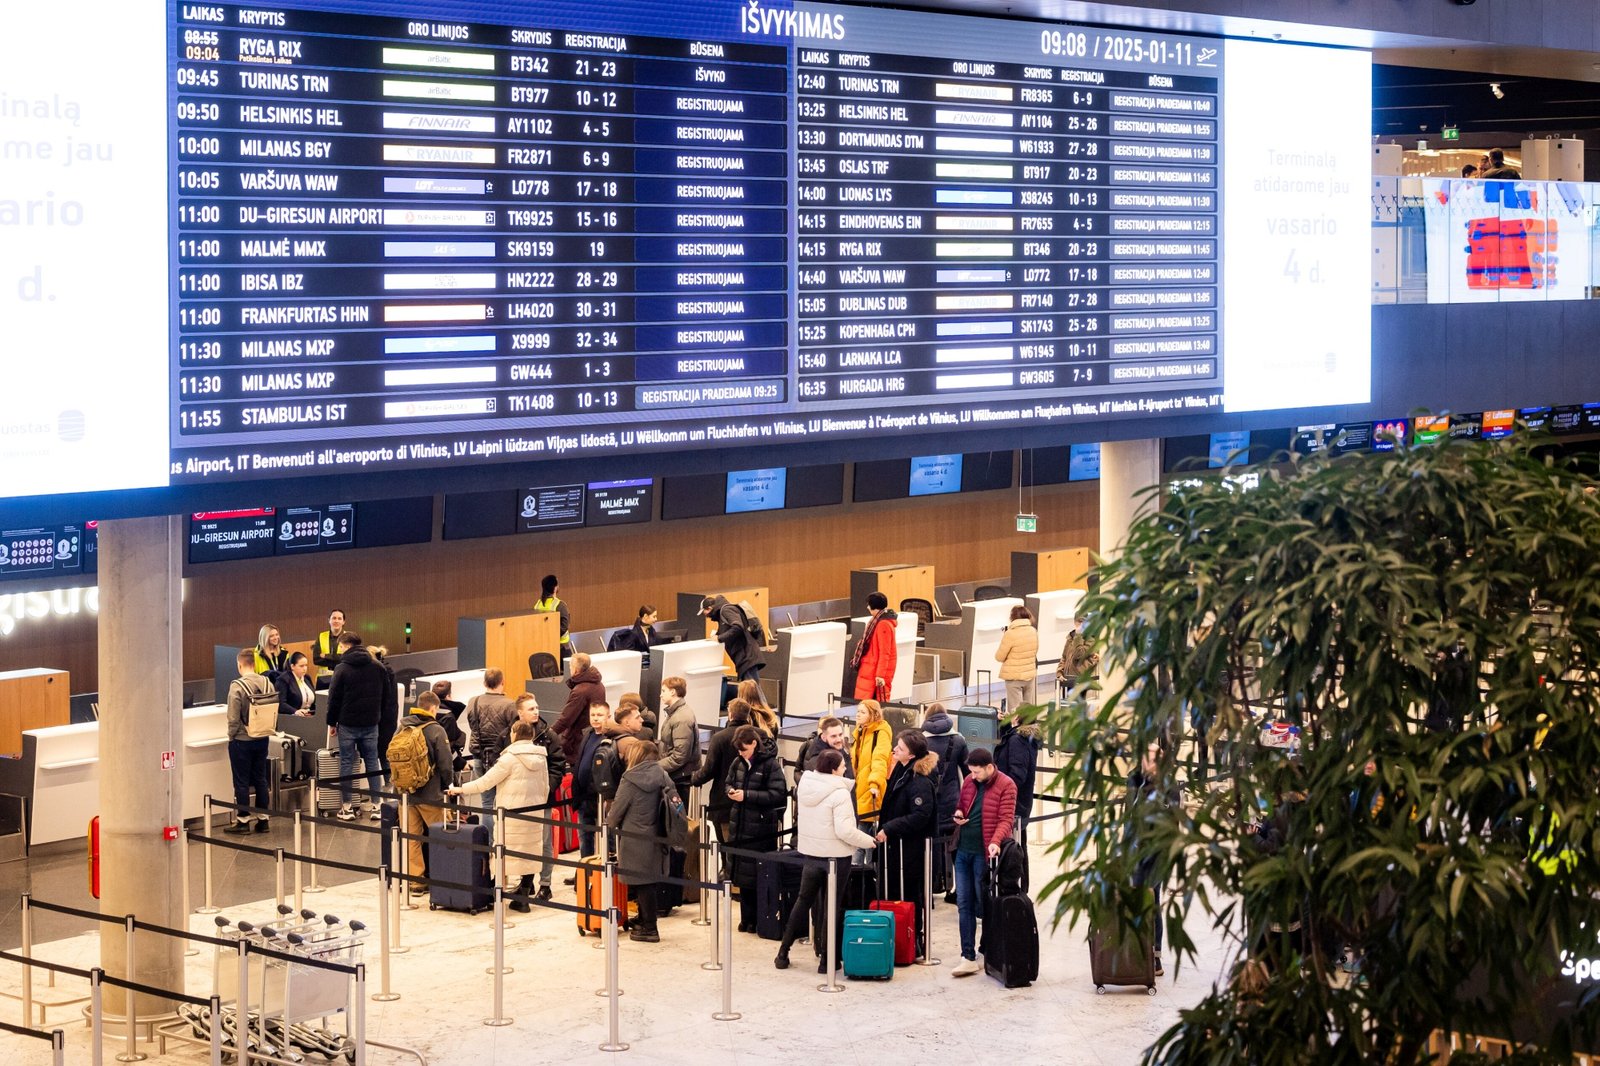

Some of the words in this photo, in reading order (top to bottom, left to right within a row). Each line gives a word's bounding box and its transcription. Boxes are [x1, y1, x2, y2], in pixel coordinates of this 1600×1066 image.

[184, 6, 224, 21] LAIKAS
[239, 10, 285, 25] KRYPTIS
[742, 1, 845, 40] IŠVYKIMAS
[184, 30, 219, 46] 08:55
[408, 22, 429, 36] ORO
[432, 24, 468, 40] LINIJOS
[512, 30, 551, 44] SKRYDIS
[239, 38, 275, 56] RYGA
[279, 40, 302, 58] RIX
[566, 34, 626, 52] REGISTRACIJA
[691, 42, 724, 56] BŪSENA
[1041, 30, 1087, 57] 09:08
[1093, 36, 1100, 57] /
[1104, 36, 1191, 66] 2025-01-11
[186, 46, 219, 61] 09:04
[511, 56, 548, 72] BT342
[177, 68, 218, 86] 09:45
[239, 72, 298, 90] TURINAS
[302, 75, 328, 92] TRN
[696, 67, 725, 82] IŠVYKO
[799, 75, 825, 89] 12:40
[839, 77, 879, 92] TURINAS
[881, 80, 899, 93] TRN
[512, 87, 548, 103] BT977
[177, 103, 219, 120] 09:50
[677, 98, 743, 113] REGISTRUOJAMA
[799, 103, 825, 116] 13:25
[839, 105, 888, 120] HELSINKIS
[891, 107, 908, 121] HEL
[241, 106, 312, 124] HELSINKIS
[317, 109, 342, 125] HEL
[408, 116, 471, 129] FINNAIR
[508, 118, 552, 134] AY1102
[677, 127, 743, 142] REGISTRUOJAMA
[799, 131, 825, 144] 13:30
[839, 132, 902, 147] DORTMUNDAS
[905, 135, 923, 148] DTM
[3, 141, 53, 160] me
[63, 136, 113, 167] jau
[179, 137, 219, 154] 10:00
[241, 140, 301, 157] MILANAS
[305, 142, 331, 157] BGY
[416, 148, 473, 161] RYANAIR
[508, 149, 551, 164] FR2871
[677, 156, 744, 171] REGISTRUOJAMA
[799, 159, 825, 172] 13:45
[840, 160, 869, 173] OSLAS
[871, 161, 889, 174] TRF
[179, 172, 219, 188] 10:05
[240, 170, 301, 190] VARŠUVA
[305, 175, 338, 190] WAW
[1254, 175, 1325, 194] atidarome
[1328, 177, 1350, 198] jau
[678, 186, 744, 200] REGISTRUOJAMA
[799, 187, 825, 200] 14:00
[840, 187, 873, 201] LIONAS
[876, 188, 892, 201] LYS
[180, 206, 219, 222] 11:00
[329, 208, 382, 224] AIRPORT
[508, 211, 553, 225] TK9925
[678, 215, 744, 228] REGISTRUOJAMA
[799, 215, 825, 228] 14:15
[840, 215, 904, 228] EINDHOVENAS
[906, 216, 921, 229] EIN
[1266, 212, 1337, 236] vasario
[180, 240, 219, 256] 11:00
[241, 238, 290, 256] MALMĖ
[294, 241, 326, 256] MMX
[508, 241, 553, 256] SK9159
[678, 244, 744, 257] REGISTRUOJAMA
[799, 243, 825, 256] 14:15
[840, 242, 863, 255] RYGA
[866, 243, 881, 256] RIX
[1283, 248, 1302, 285] 4
[1309, 259, 1327, 285] d.
[180, 274, 220, 291] 11:00
[242, 274, 278, 290] IBISA
[282, 274, 303, 290] IBZ
[508, 272, 554, 287] HN2222
[678, 273, 744, 286] REGISTRUOJAMA
[799, 270, 825, 284] 14:40
[839, 267, 881, 283] VARŠUVA
[883, 270, 905, 283] WAW
[17, 265, 57, 302] d.
[509, 303, 553, 318] LH4020
[678, 301, 744, 315] REGISTRUOJAMA
[799, 298, 825, 312] 15:05
[840, 297, 886, 311] DUBLINAS
[888, 297, 907, 310] DUB
[180, 308, 220, 325] 11:00
[242, 307, 337, 324] FRANKFURTAS
[341, 306, 368, 322] HHN
[678, 330, 744, 344] REGISTRUOJAMA
[799, 326, 825, 340] 15:25
[840, 324, 895, 338] KOPENHAGA
[897, 323, 915, 337] CPH
[242, 340, 302, 357] MILANAS
[306, 340, 334, 355] MXP
[512, 334, 550, 349] X9999
[181, 342, 220, 359] 11:30
[678, 359, 744, 372] REGISTRUOJAMA
[799, 354, 826, 368] 15:40
[840, 352, 883, 366] LARNAKA
[885, 351, 901, 364] LCA
[511, 364, 552, 380] GW444
[178, 376, 221, 393] 11:30
[242, 373, 302, 391] MILANAS
[306, 372, 335, 388] MXP
[799, 381, 826, 396] 16:35
[840, 378, 884, 394] HURGADA
[886, 377, 904, 391] HRG
[643, 390, 700, 403] REGISTRACIJA
[703, 387, 752, 400] PRADEDAMA
[754, 386, 777, 397] 09:25
[508, 394, 554, 411] TK1408
[181, 410, 221, 428] 11:55
[242, 405, 322, 424] STAMBULAS
[326, 404, 347, 420] IST
[186, 457, 233, 476] Airport,
[238, 454, 249, 470] IT
[253, 450, 314, 469] Benvenuti
[318, 447, 393, 466] all'aeroporto
[397, 444, 406, 460] di
[410, 443, 450, 459] Vilnius,
[454, 441, 467, 456] LV
[470, 439, 502, 458] Laipni
[506, 437, 544, 453] lūdzam
[621, 431, 633, 446] LU
[690, 429, 704, 441] um
[708, 423, 758, 440] Fluchhafen
[761, 425, 771, 436] vu
[774, 421, 806, 435] Vilnius,
[624, 497, 639, 507] MMX
[241, 528, 275, 540] AIRPORT
